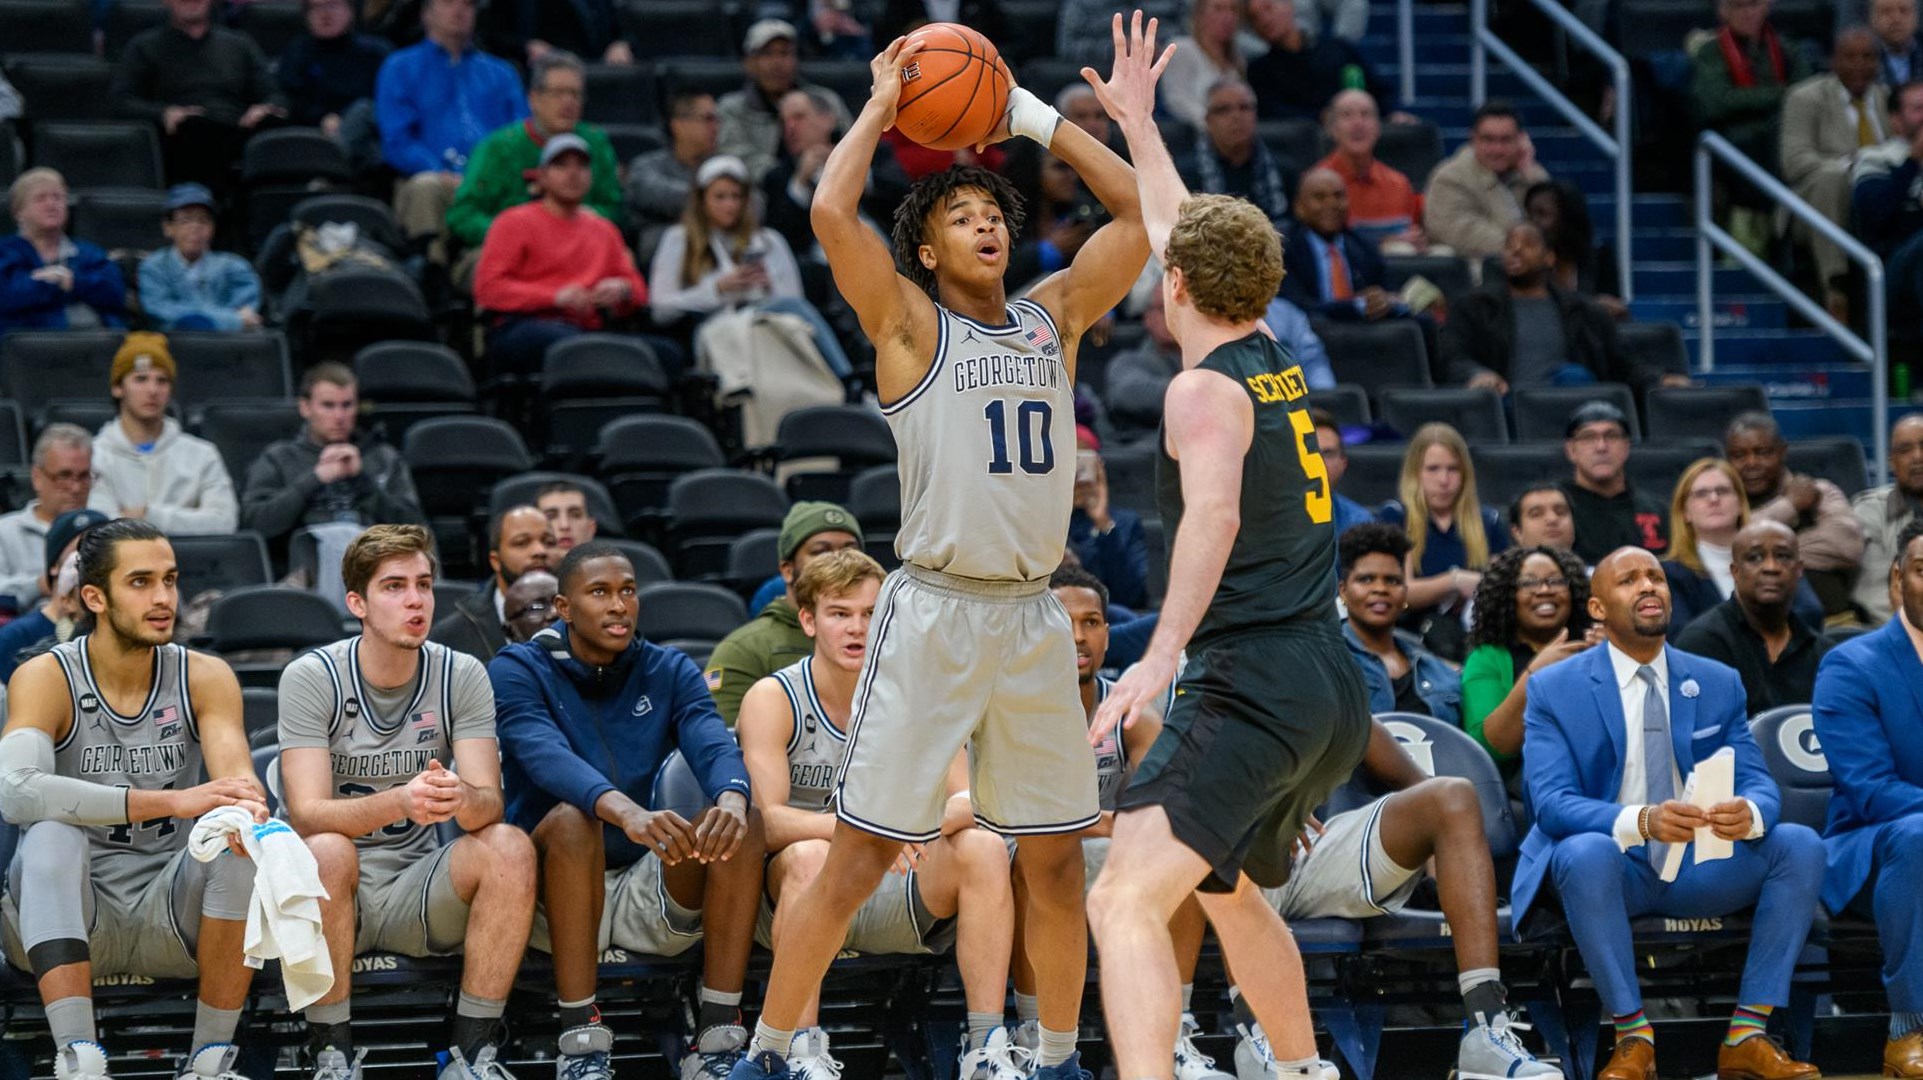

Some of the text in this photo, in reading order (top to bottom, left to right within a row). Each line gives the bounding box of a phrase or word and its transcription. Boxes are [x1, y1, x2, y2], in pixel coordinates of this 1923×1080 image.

[983, 399, 1055, 475] 10
[1287, 409, 1332, 524] 5
[80, 743, 185, 774] GEORETWN
[1664, 918, 1723, 932] HOYAS
[352, 956, 398, 972] OYAS
